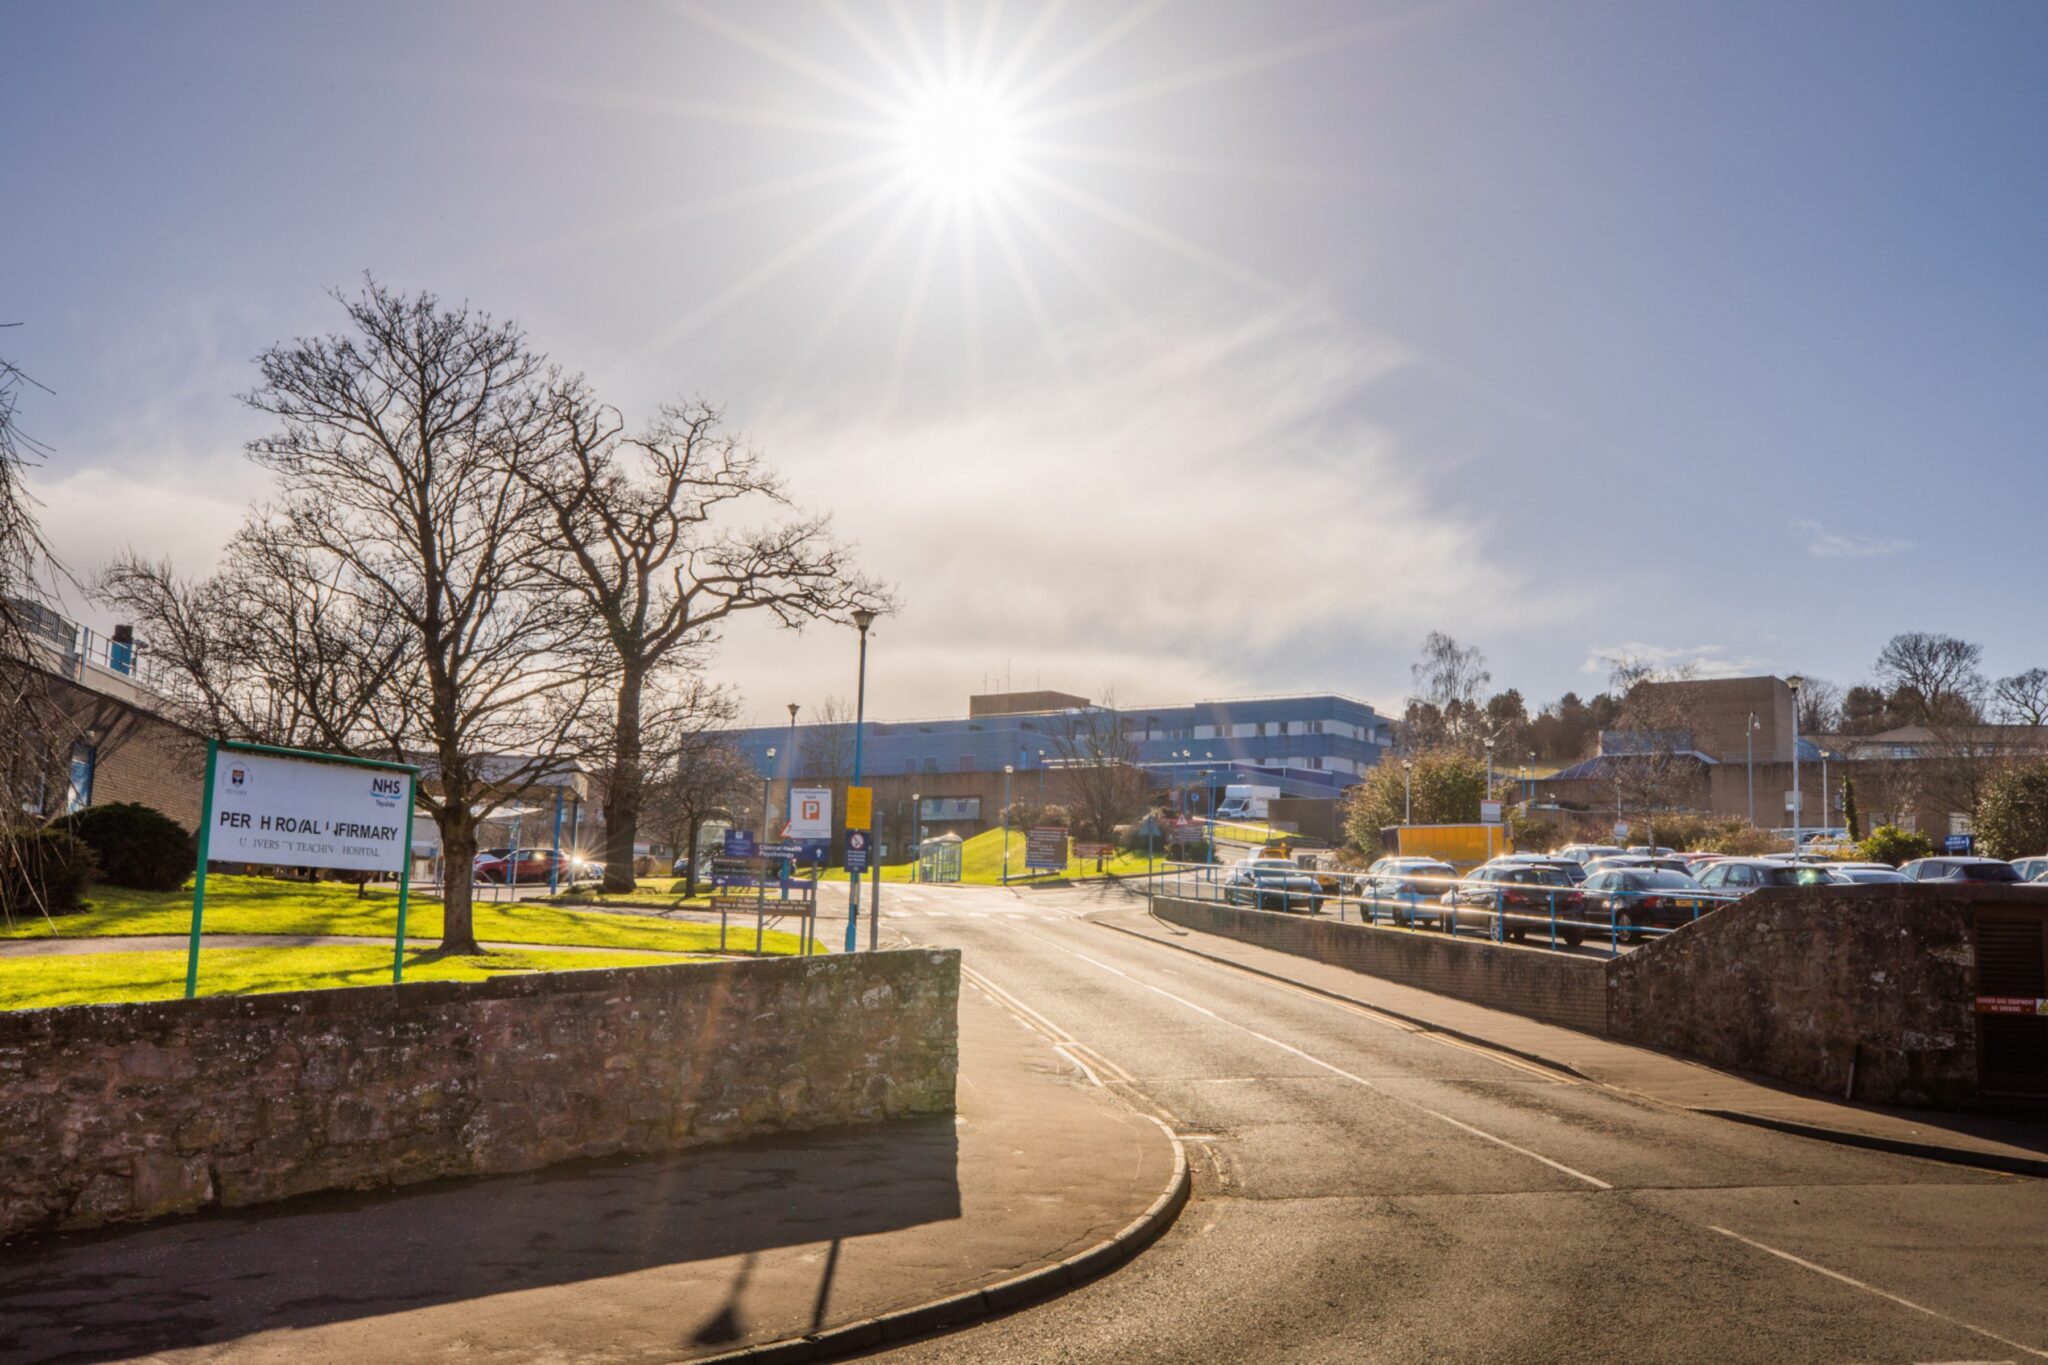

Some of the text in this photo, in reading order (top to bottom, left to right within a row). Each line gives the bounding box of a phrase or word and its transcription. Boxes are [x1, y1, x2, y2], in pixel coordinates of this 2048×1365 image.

[373, 777, 401, 795] NHS
[376, 799, 395, 808] Tayside
[220, 811, 271, 830] PERH
[295, 842, 334, 854] TEACHIN
